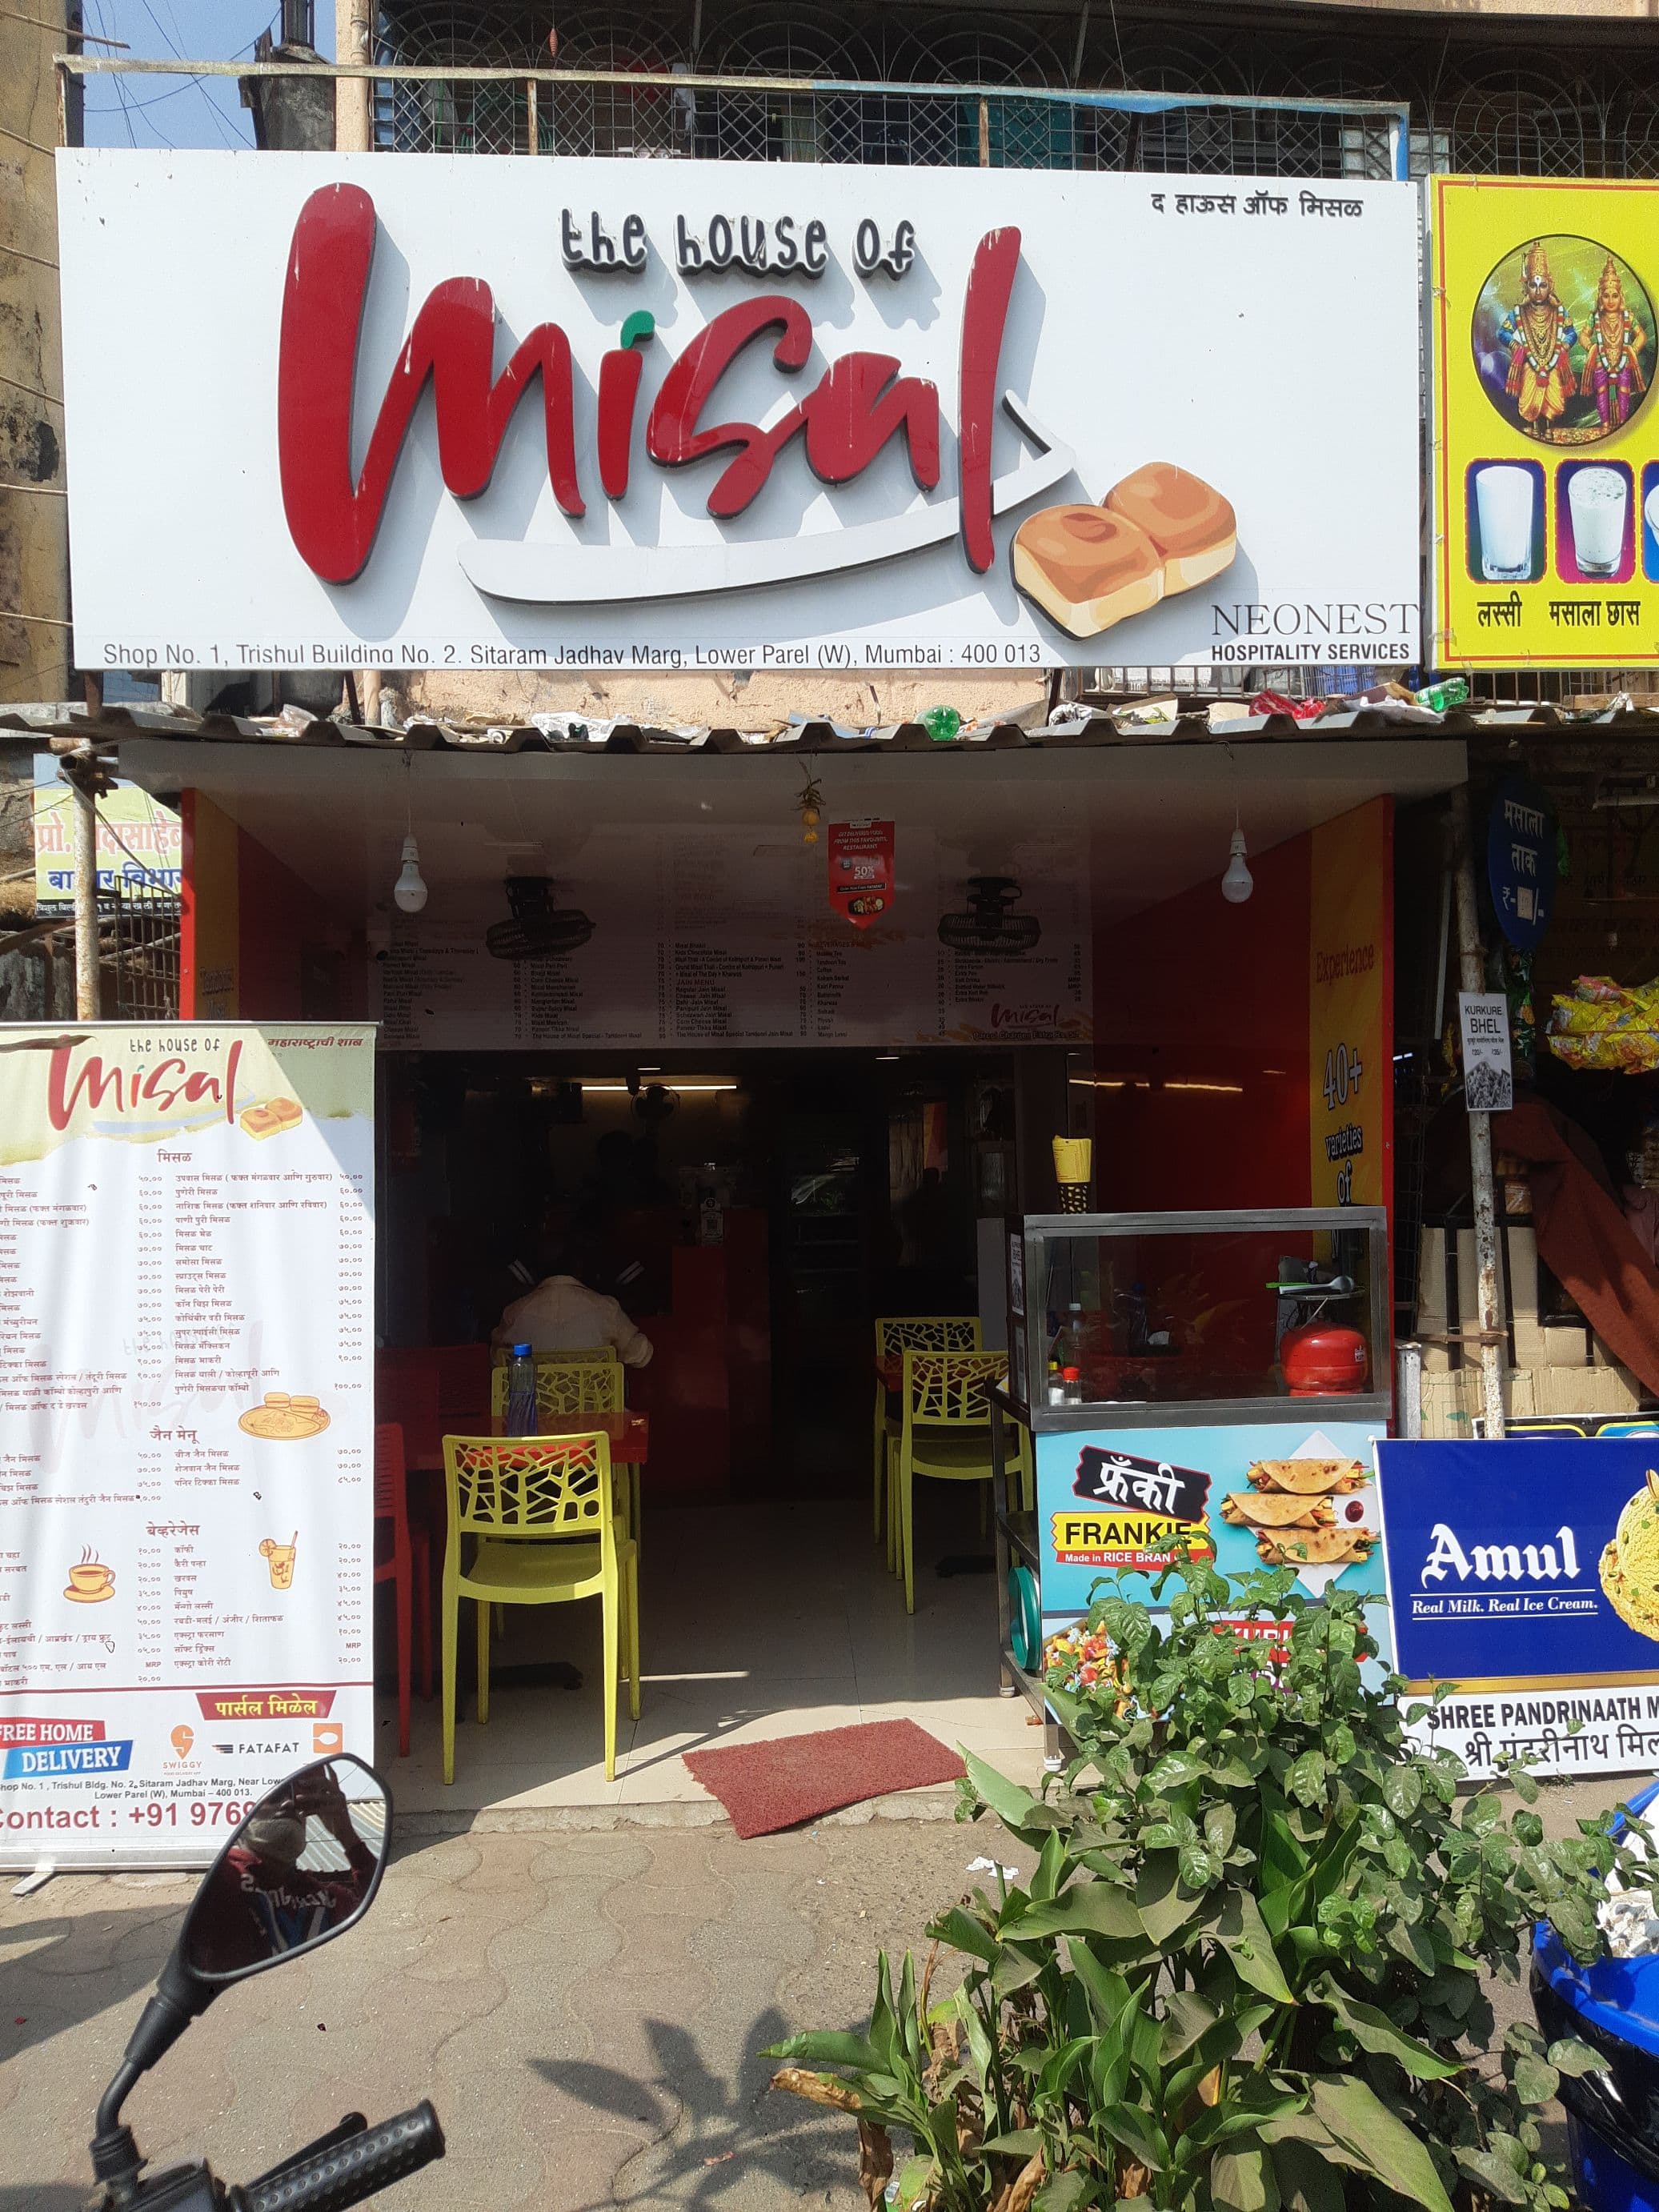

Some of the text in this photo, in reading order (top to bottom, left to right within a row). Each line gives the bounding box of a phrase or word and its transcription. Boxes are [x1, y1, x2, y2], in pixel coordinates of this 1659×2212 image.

[1151, 189, 1364, 217] द हाऊस ऑफ मिसळ
[561, 208, 915, 271] the house of
[1477, 590, 1523, 627] लस्सी
[1549, 600, 1641, 627] मसाला छास
[1211, 603, 1420, 636] NEONEST
[104, 643, 158, 668] Shop
[167, 644, 201, 664] No.
[210, 644, 229, 667] 1,
[237, 644, 303, 664] Trishul
[402, 644, 435, 664] No.
[471, 645, 547, 665] Sitaram
[555, 645, 625, 665] Jadhav
[632, 645, 687, 669] Marg,
[696, 645, 755, 664] Lower
[763, 644, 809, 664] Parel
[819, 644, 858, 669] (W),
[866, 644, 941, 664] Mumbai
[961, 644, 997, 663] 400
[1005, 644, 1040, 663] 013
[1212, 643, 1410, 661] HOSPITALITY SERVICES
[1505, 799, 1544, 840] मसाला
[1510, 842, 1537, 877] ताक
[1316, 943, 1375, 985] Experience
[1465, 1005, 1503, 1016] KURKURE
[1470, 1018, 1501, 1034] BHEL
[130, 1037, 221, 1052] the house of
[268, 1036, 364, 1049] महाराष्ट्राची शान
[1323, 1043, 1362, 1111] 40+
[1325, 1123, 1363, 1162] varieties
[157, 1148, 193, 1164] मिसळ
[202, 1172, 223, 1181] मिसळ
[283, 1172, 303, 1180] आणि
[1336, 1159, 1353, 1204] of
[175, 1187, 195, 1199] पुणेरी
[197, 1187, 218, 1196] मिसळ
[175, 1201, 202, 1210] नाशिक
[203, 1200, 224, 1209] मिसळ
[250, 1200, 276, 1209] शनिवार
[279, 1200, 299, 1208] आणि
[340, 1201, 363, 1209] ६०.००
[175, 1215, 194, 1224] पाणी
[195, 1215, 208, 1226] पुरी
[209, 1214, 231, 1224] मिसळ
[175, 1228, 363, 1238] मिसळ भेळ ६०.००
[175, 1285, 197, 1294] मिसळ
[198, 1284, 211, 1293] पेरी
[213, 1284, 225, 1293] पेरी
[175, 1356, 197, 1364] मिसळ
[198, 1355, 222, 1364] भाकरी
[149, 1425, 200, 1445] जैन मेनू
[174, 1477, 193, 1487] पनिर
[194, 1477, 218, 1486] टिक्का
[218, 1477, 241, 1485] मिसळ
[146, 1521, 201, 1539] बेव्हरेजेस
[174, 1545, 194, 1553] कॉफी
[1065, 1553, 1090, 1563] Made
[1092, 1553, 1101, 1563] in
[1103, 1552, 1133, 1563] RICE
[1135, 1552, 1172, 1563] BRAN
[1421, 1523, 1581, 1590] Amul
[1413, 1596, 1599, 1614] Real Milk. Real Ice Cream.
[217, 1693, 319, 1717] पार्सल मिळेल
[1426, 1704, 1496, 1730] SHREE
[1500, 1697, 1641, 1729] PANDRINAATH
[40, 1723, 94, 1742] HOME
[239, 1741, 301, 1754] FATAFAT
[1465, 1731, 1493, 1767] श्री
[22, 1745, 122, 1773] DELIVERY
[162, 1761, 202, 1769] SWIGGY
[22, 1781, 38, 1790] No.
[54, 1780, 85, 1789] Trishul
[86, 1780, 110, 1791] Bldg.
[112, 1780, 129, 1789] No.
[141, 1779, 175, 1788] Sitaram
[177, 1778, 210, 1787] Jadhav
[212, 1778, 238, 1788] Marg,
[239, 1777, 262, 1786] Near
[96, 1790, 124, 1800] Lower
[126, 1789, 150, 1799] Parel
[151, 1789, 170, 1800] (W),
[171, 1789, 206, 1798] Mumbai
[217, 1788, 234, 1797] 400
[130, 1801, 178, 1826] +91
